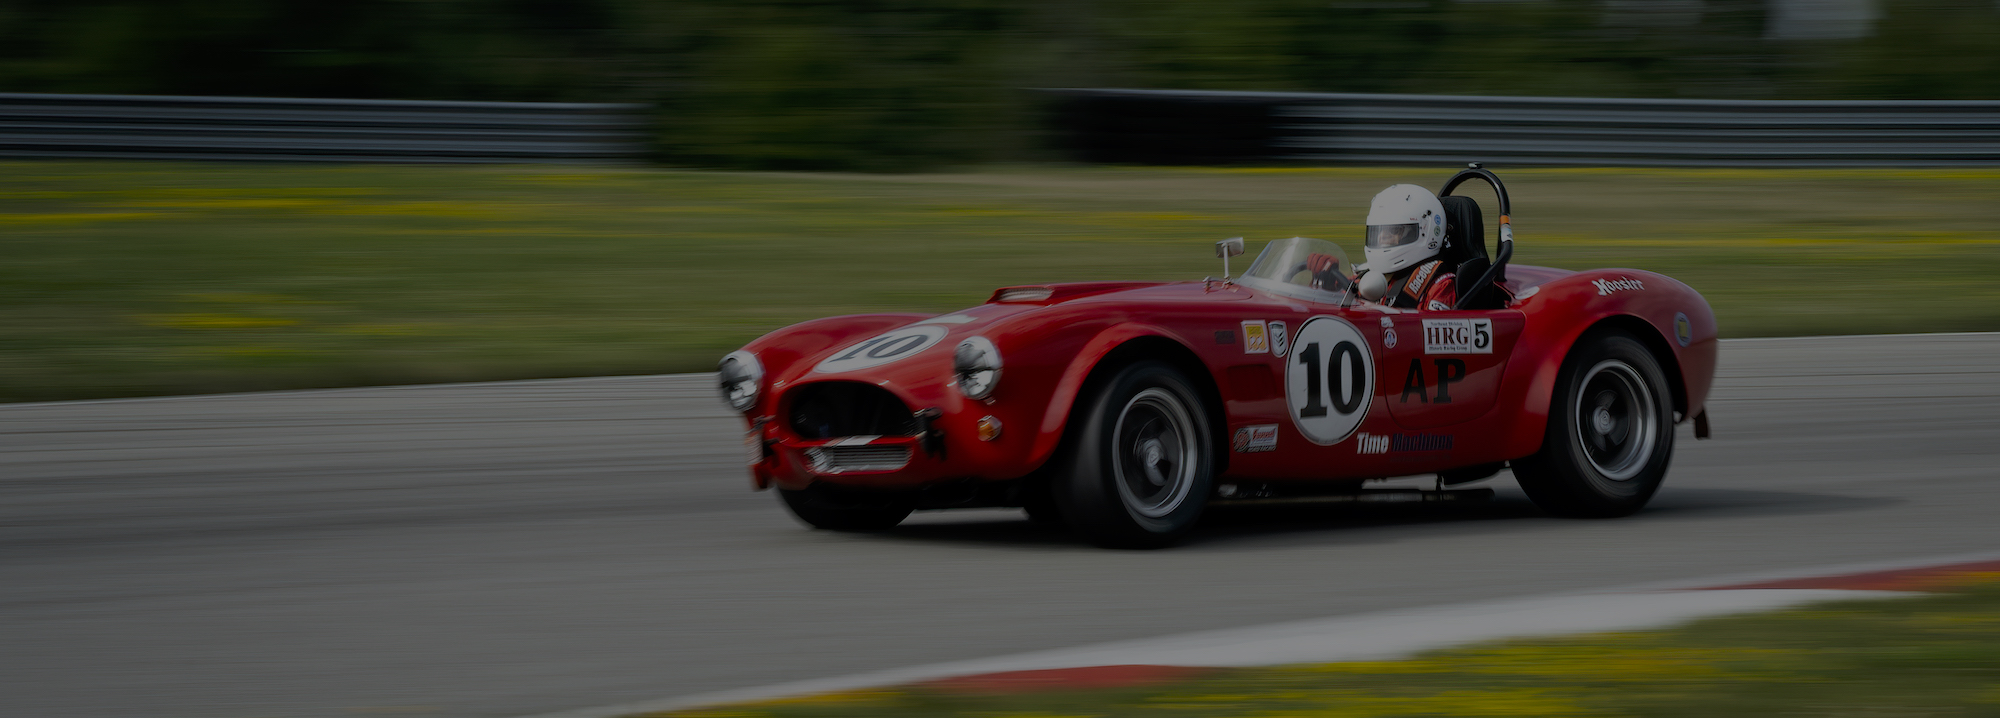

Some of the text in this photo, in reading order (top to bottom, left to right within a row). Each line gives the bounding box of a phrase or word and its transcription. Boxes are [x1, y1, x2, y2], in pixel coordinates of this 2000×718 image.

[1408, 260, 1438, 294] RaceQu
[828, 334, 928, 363] 10
[1427, 327, 1469, 346] HRG
[1474, 323, 1489, 348] 5
[1299, 341, 1366, 418] 10
[1400, 358, 1466, 404] AP
[1356, 432, 1454, 454] Time Machines
